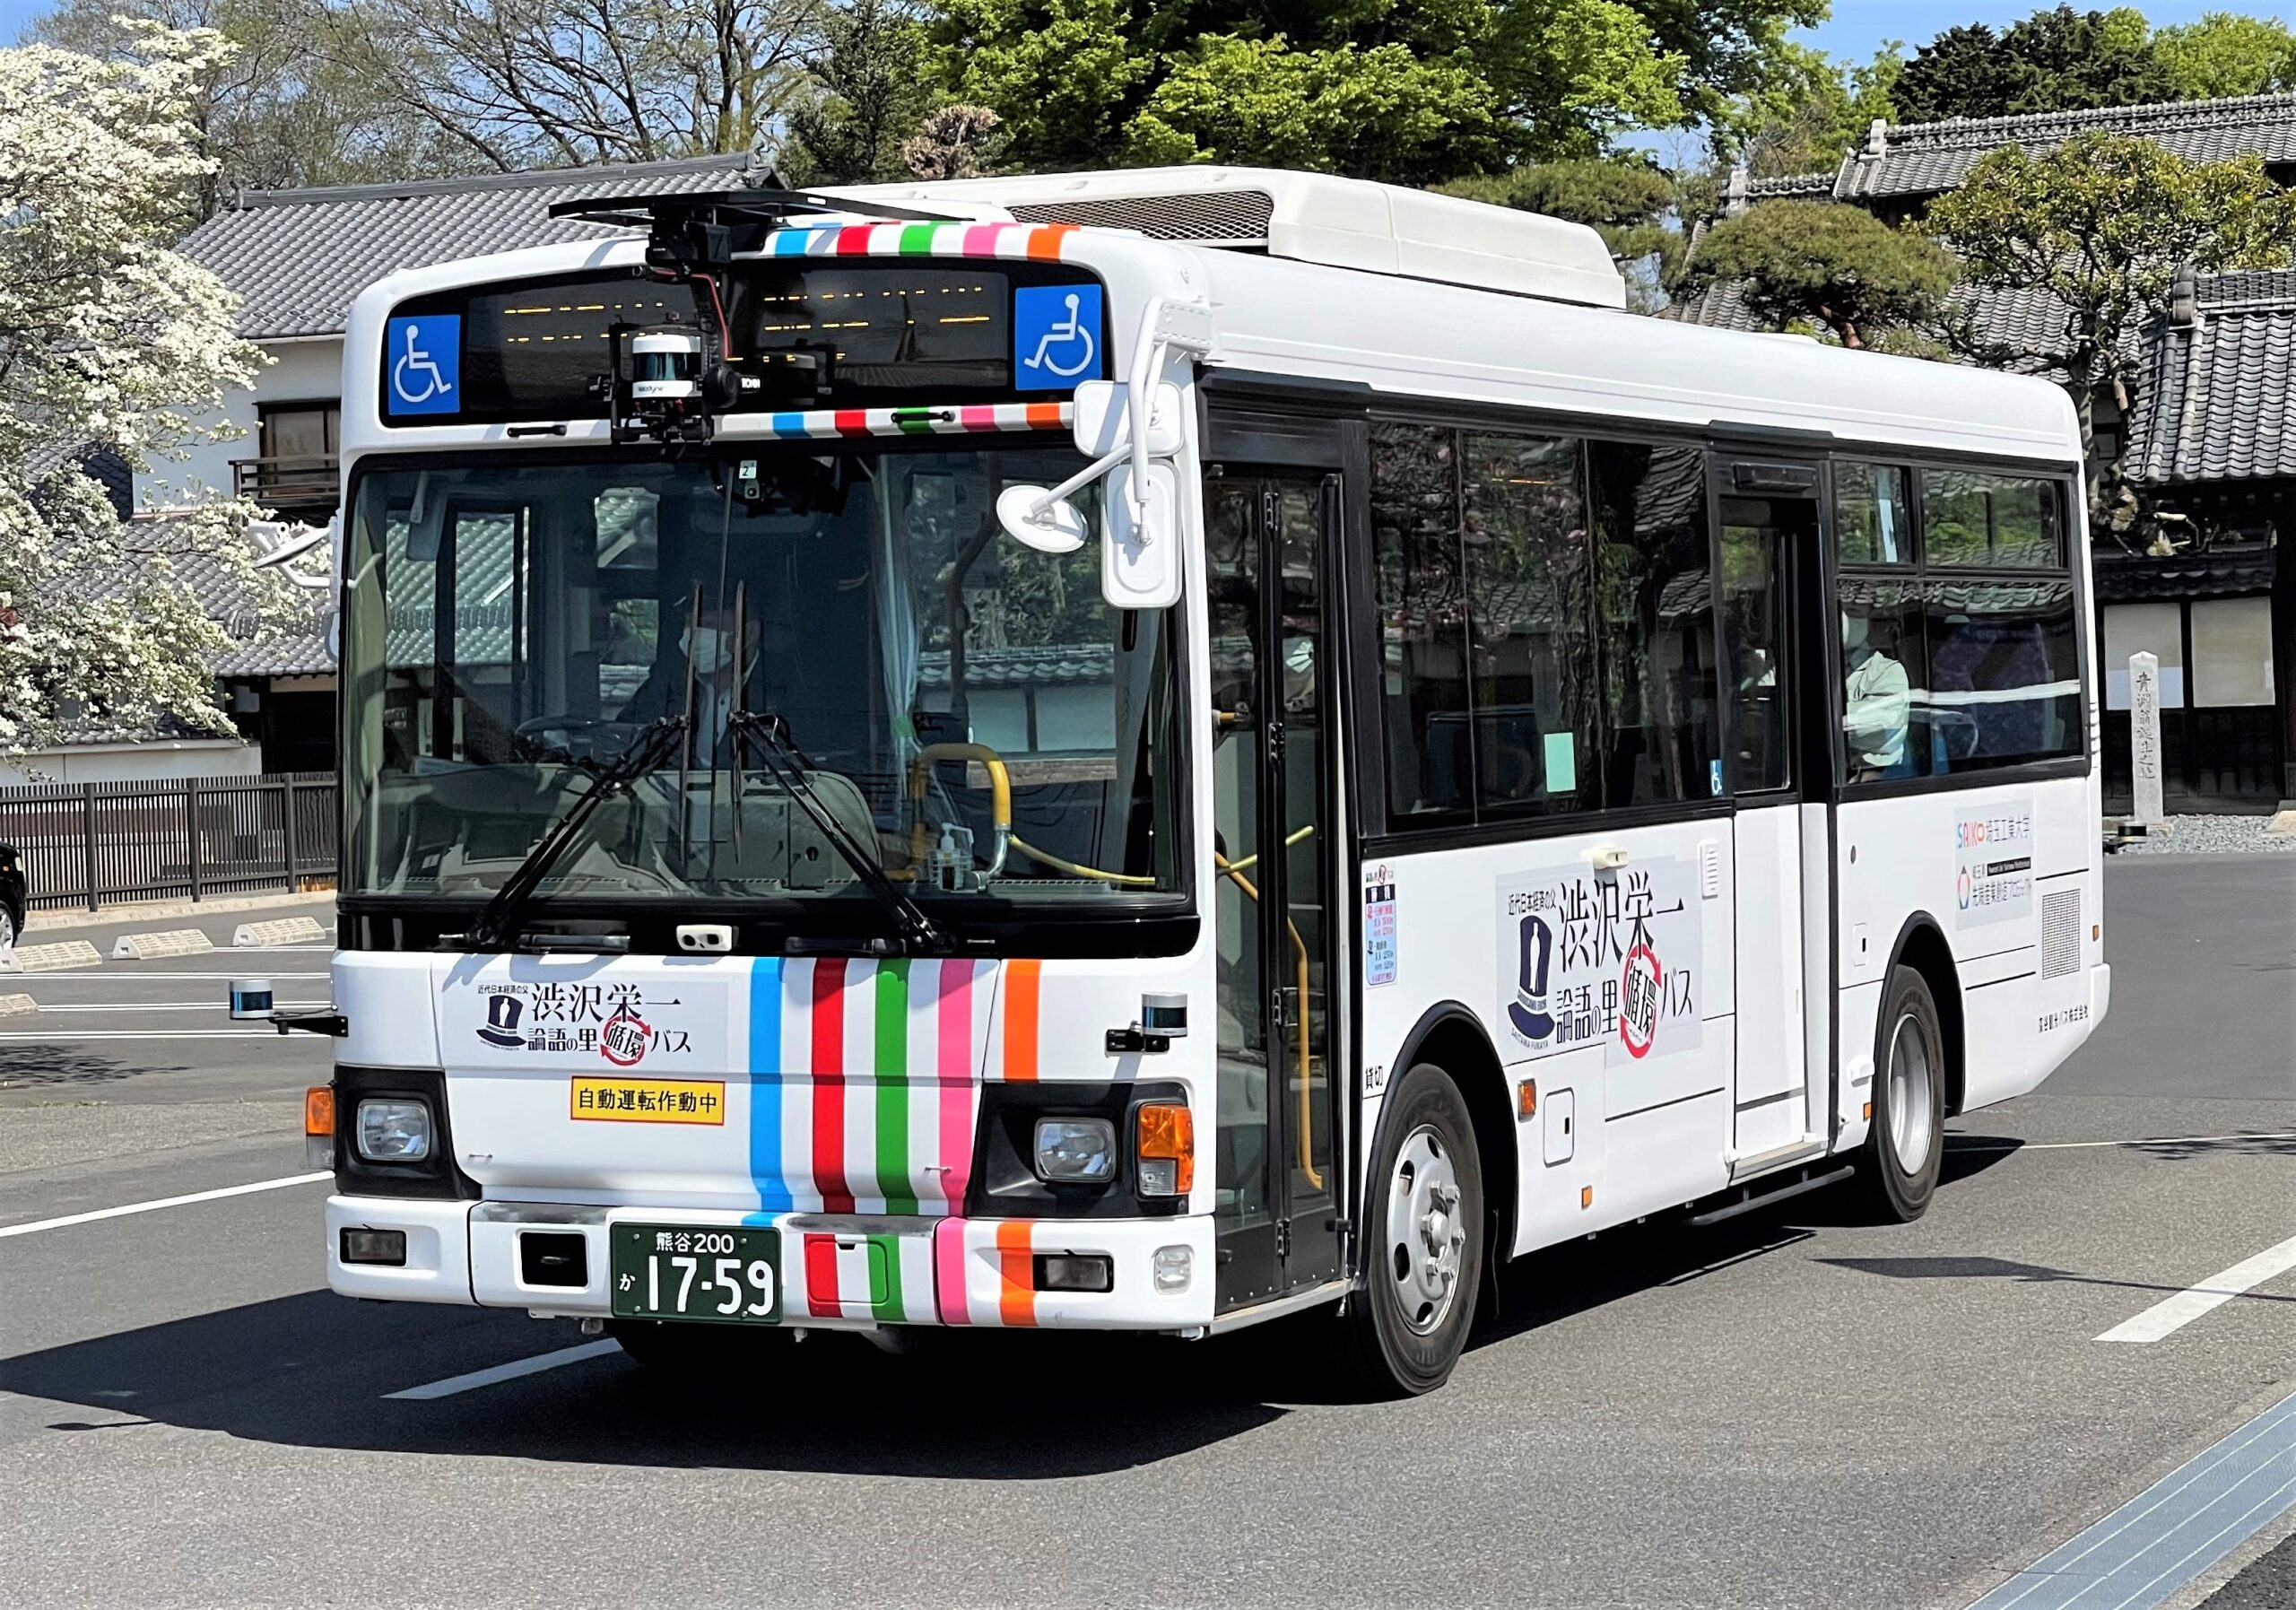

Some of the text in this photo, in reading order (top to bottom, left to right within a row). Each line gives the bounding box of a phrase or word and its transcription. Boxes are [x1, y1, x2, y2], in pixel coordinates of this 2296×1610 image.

[1559, 871, 1684, 973] 渋沢栄一
[477, 985, 528, 995] 近代日本経済の父
[531, 982, 681, 1023] 渋沢栄一
[1365, 1065, 1384, 1090] 貸切
[578, 1088, 718, 1114] 自動運転作動中
[656, 1231, 735, 1254] 熊谷200
[619, 1255, 774, 1316] か 17-59
